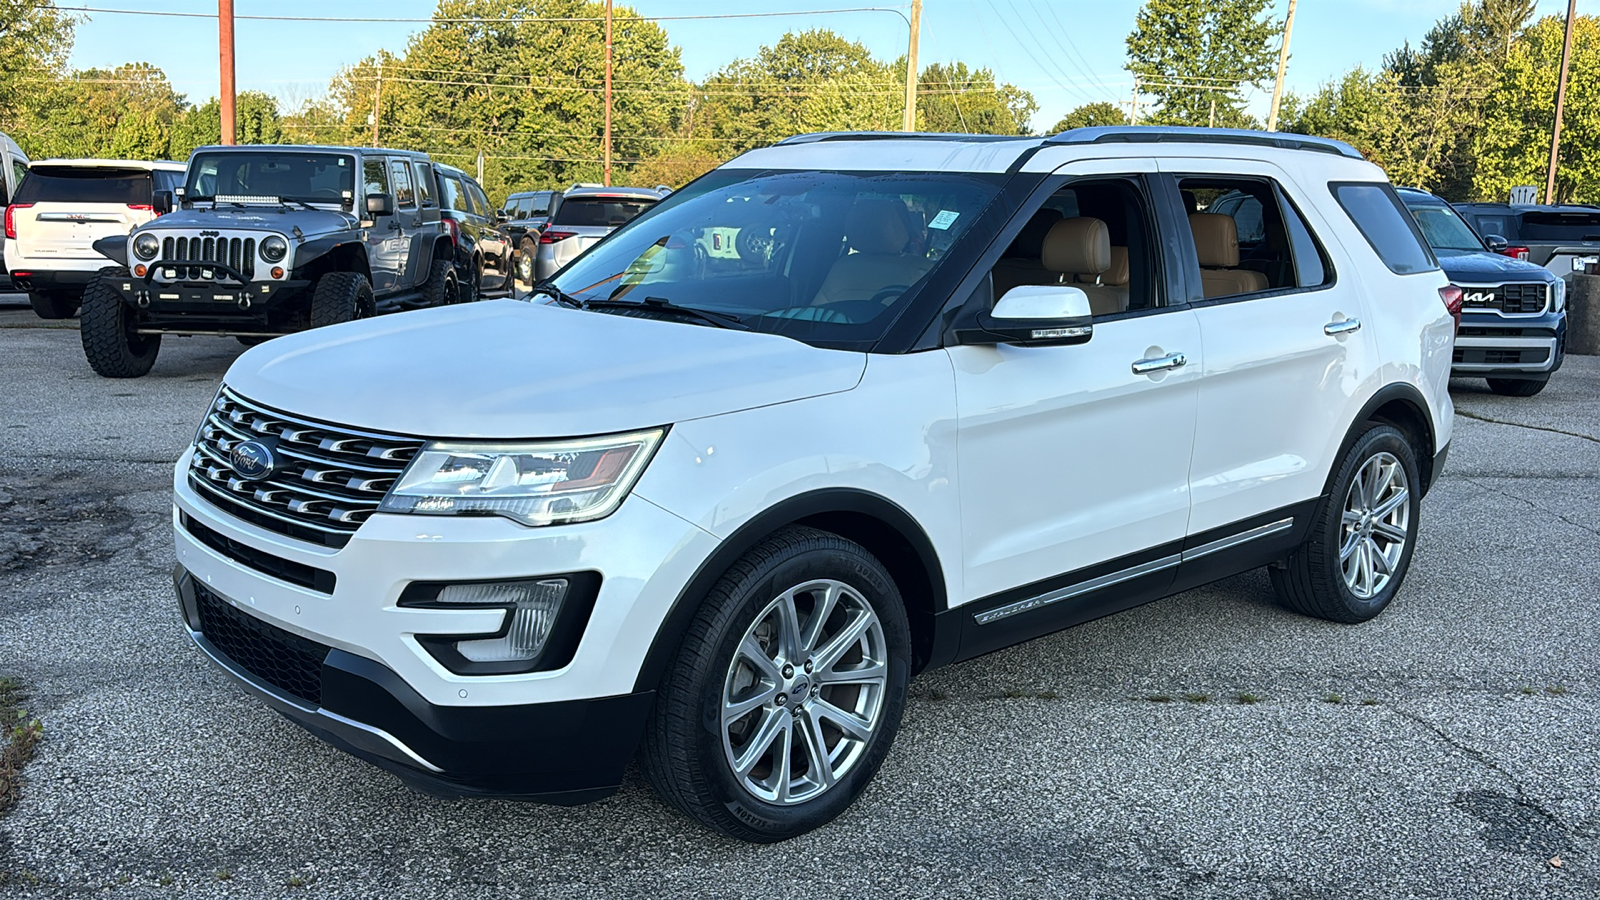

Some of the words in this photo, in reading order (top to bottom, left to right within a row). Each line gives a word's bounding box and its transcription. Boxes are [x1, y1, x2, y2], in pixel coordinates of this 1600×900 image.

[199, 230, 220, 238] Jeep
[1463, 292, 1495, 302] KIA
[234, 446, 259, 470] Ford
